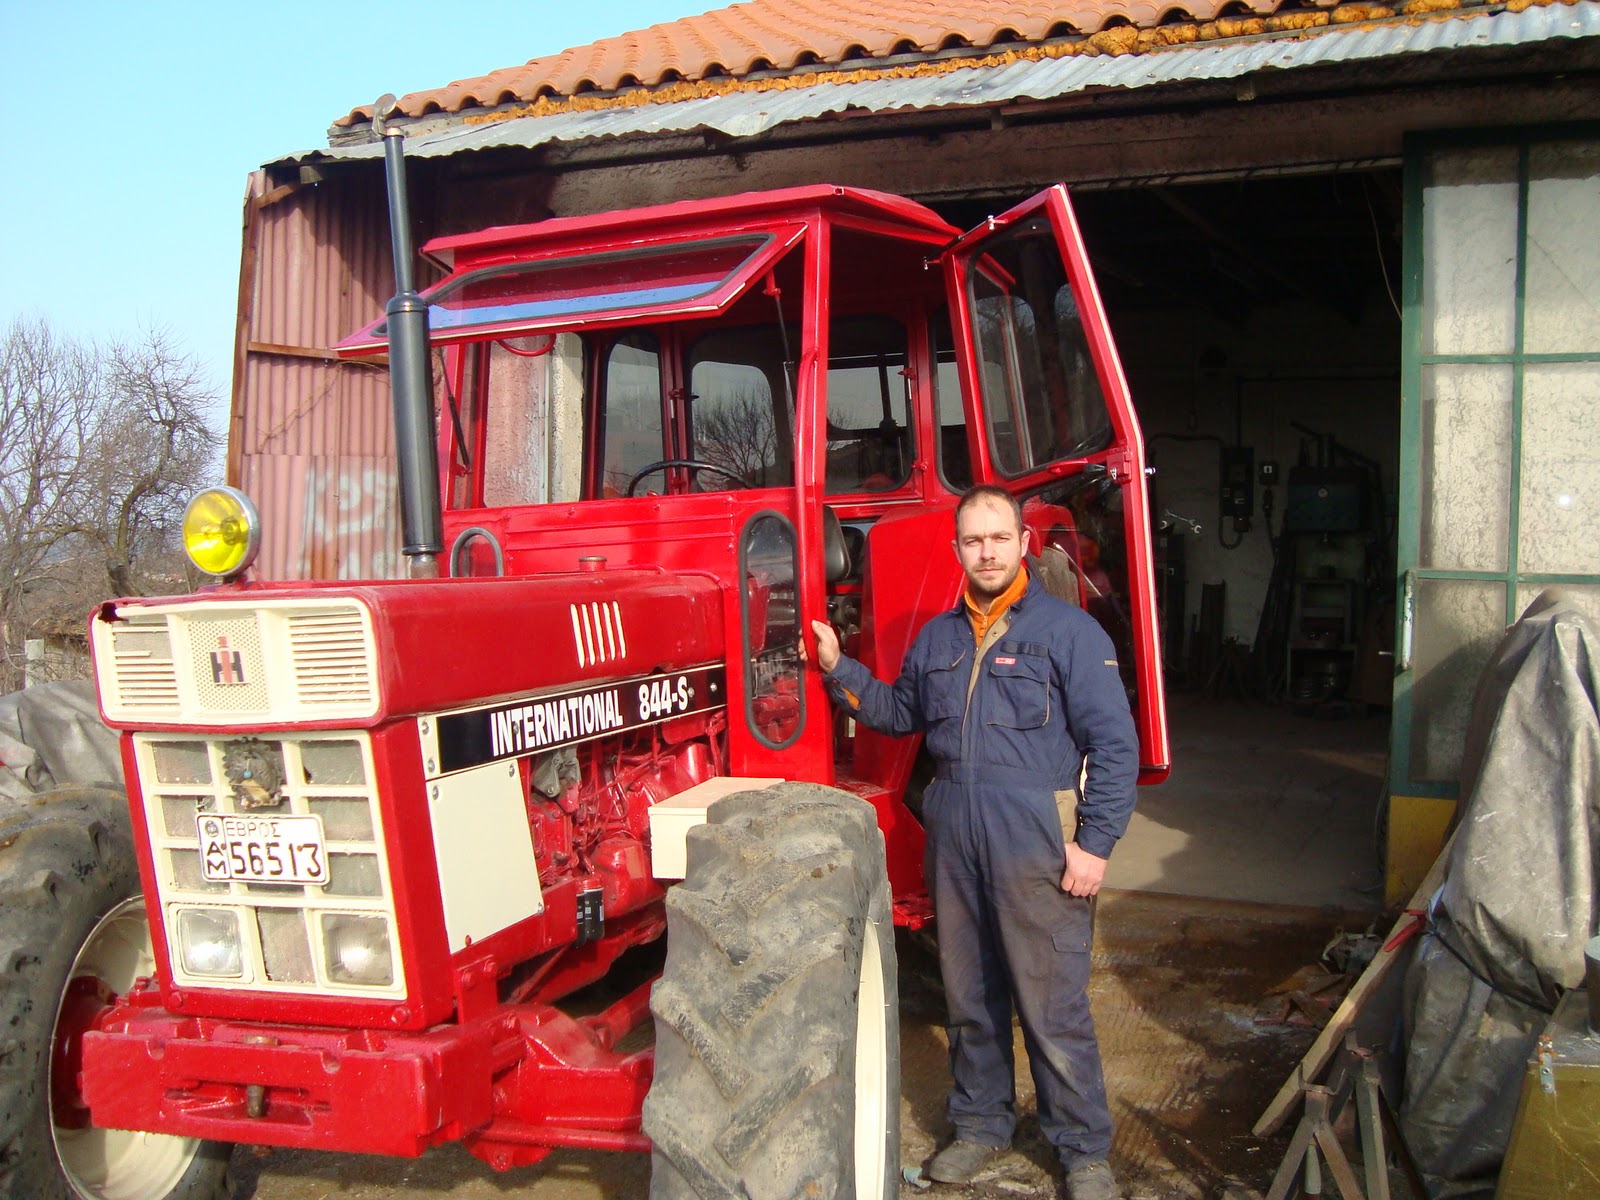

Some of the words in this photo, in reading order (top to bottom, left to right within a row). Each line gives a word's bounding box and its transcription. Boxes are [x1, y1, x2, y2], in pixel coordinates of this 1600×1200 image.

[490, 689, 623, 757] INTERNATIONAL
[638, 676, 689, 721] 844-S
[230, 841, 321, 877] 56513
